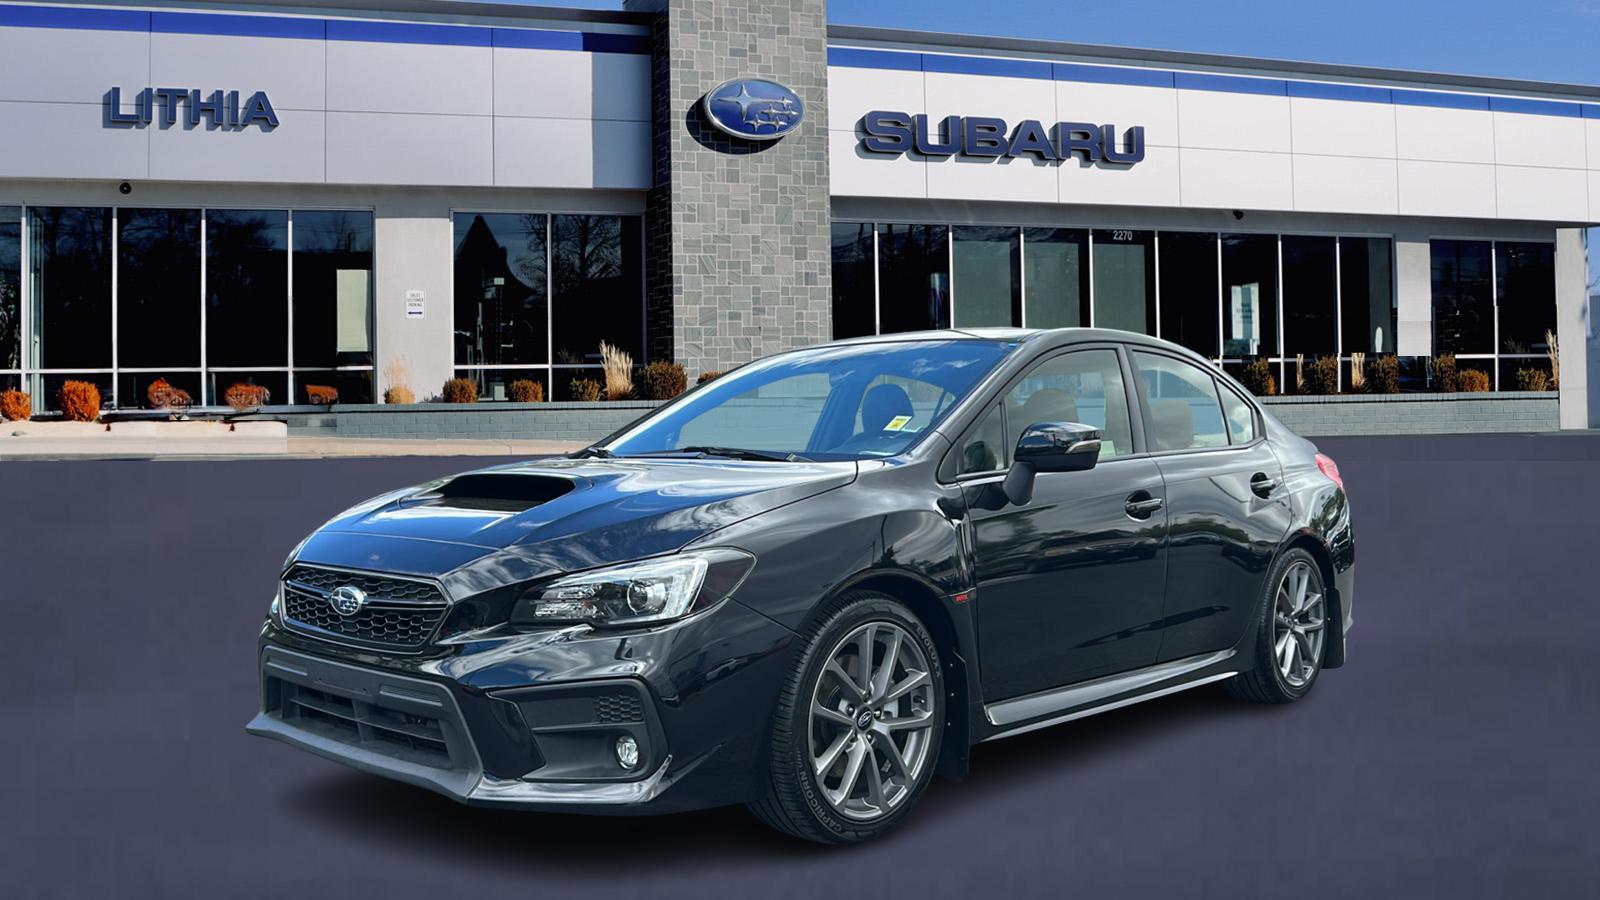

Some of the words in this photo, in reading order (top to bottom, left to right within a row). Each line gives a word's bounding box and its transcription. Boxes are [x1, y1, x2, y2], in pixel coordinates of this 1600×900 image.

[110, 87, 280, 128] LITHIA
[863, 110, 1145, 165] SUBARU
[1112, 230, 1133, 241] 2270
[800, 771, 842, 832] CAPRICORN
